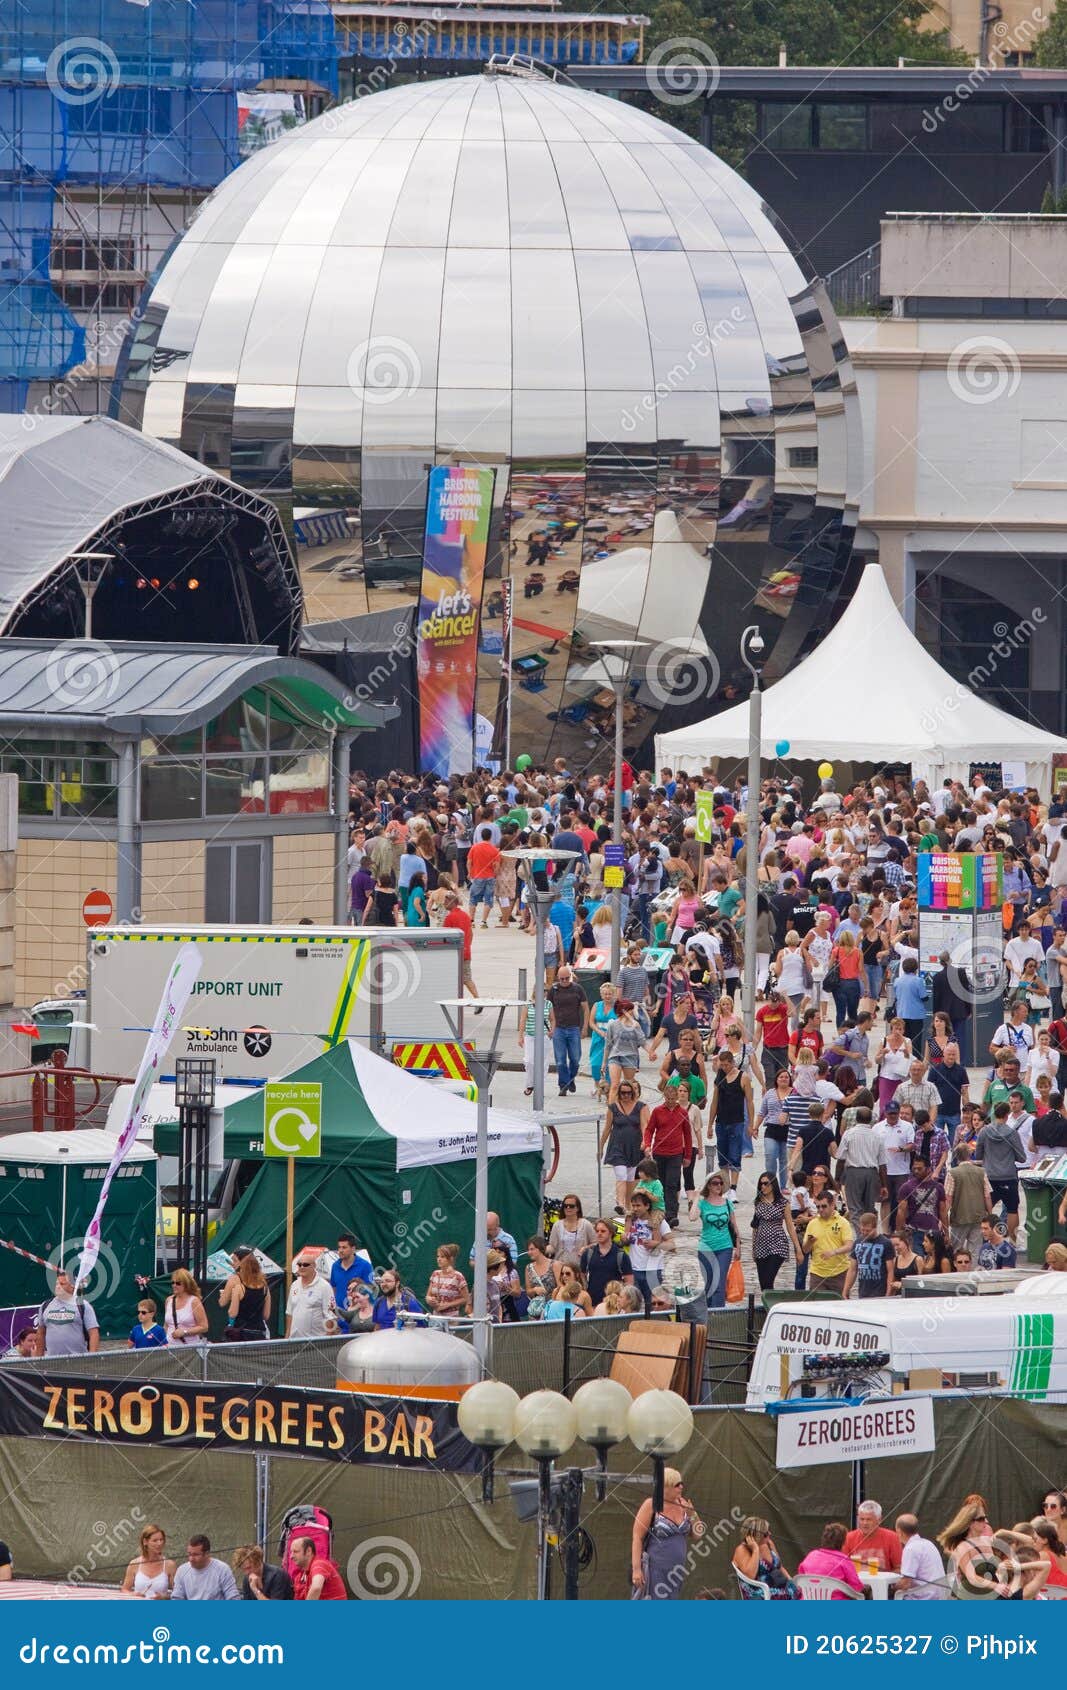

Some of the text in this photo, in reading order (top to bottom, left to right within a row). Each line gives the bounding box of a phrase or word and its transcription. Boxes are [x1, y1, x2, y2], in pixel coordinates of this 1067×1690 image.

[444, 478, 481, 491] BRISTOL
[439, 493, 482, 507] HARBOUR
[440, 508, 479, 521] FESTIVAL
[929, 866, 962, 874] HARBOUR
[191, 982, 283, 996] UPPORT UNIT
[186, 1028, 201, 1041] St
[187, 1042, 238, 1053] Ambulance
[266, 1089, 320, 1102] recycle here
[449, 1136, 465, 1146] John
[465, 1132, 501, 1144] Amnce
[781, 1323, 879, 1350] 0870 60 70 900
[364, 1409, 437, 1459] BAR
